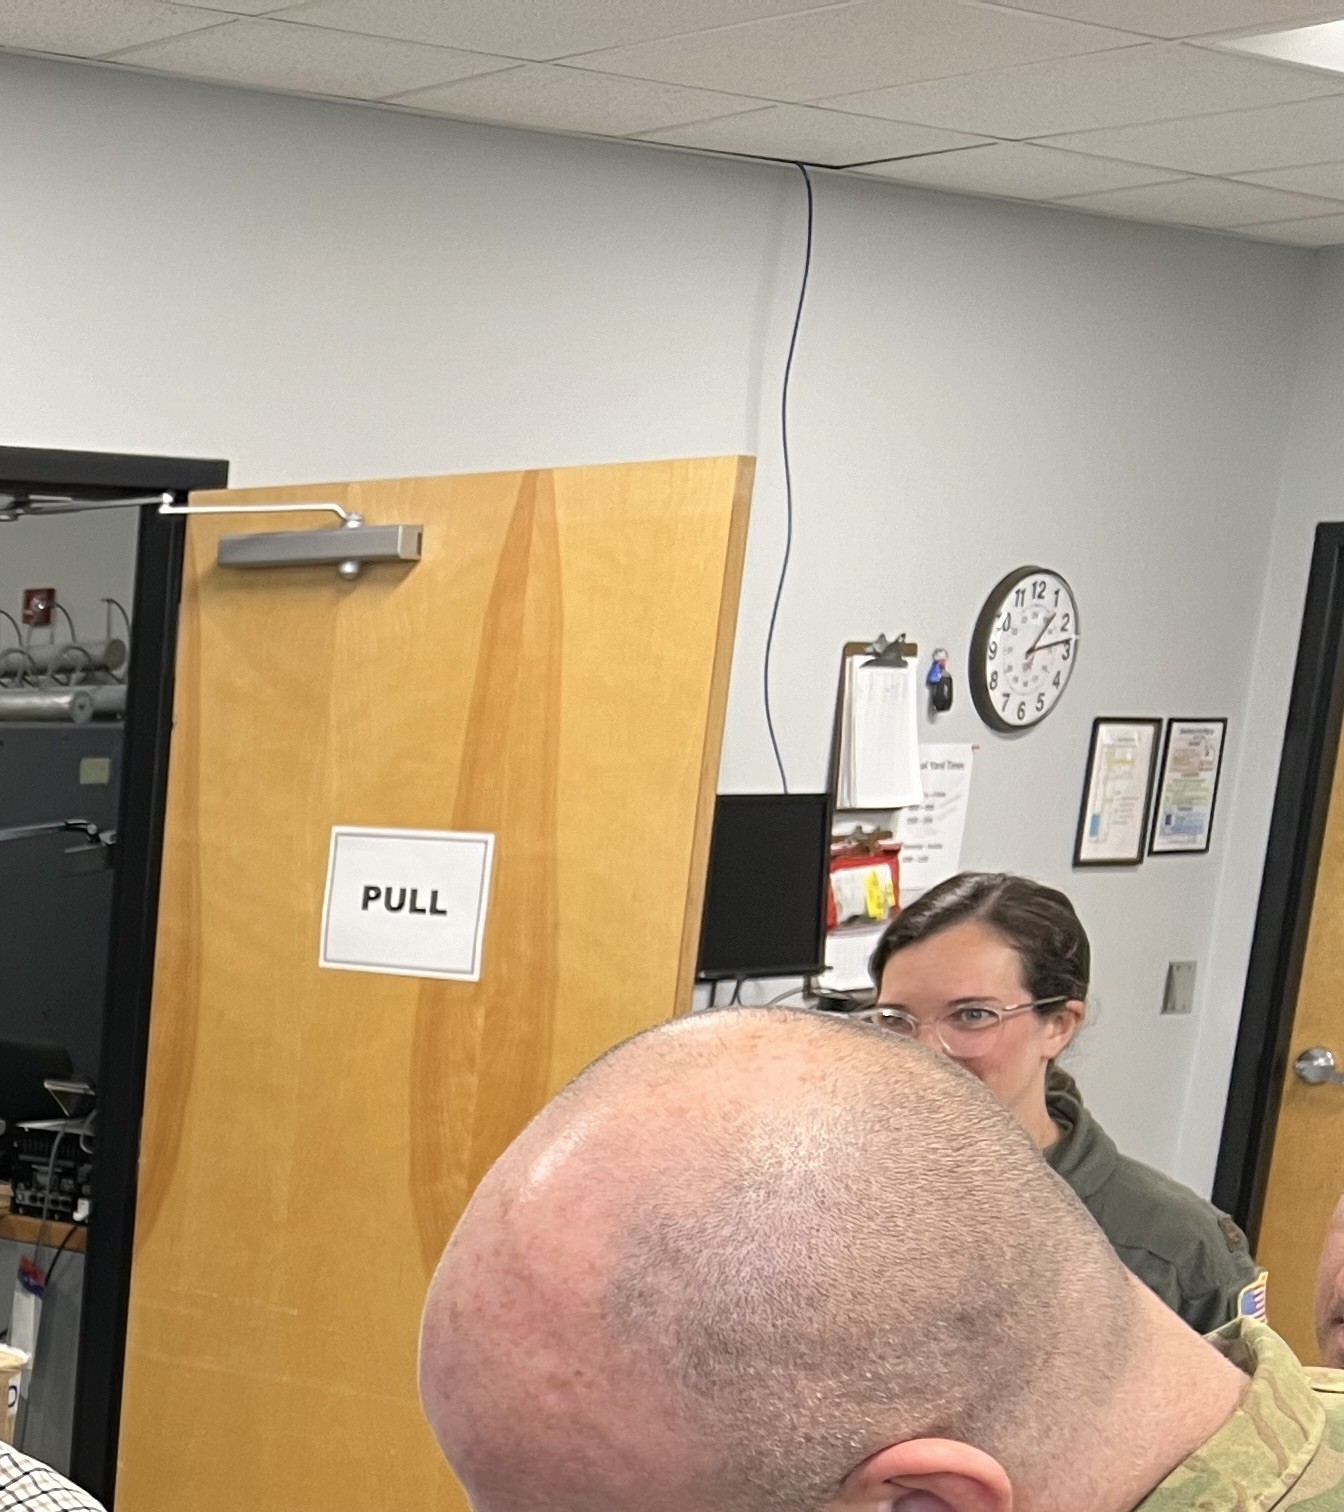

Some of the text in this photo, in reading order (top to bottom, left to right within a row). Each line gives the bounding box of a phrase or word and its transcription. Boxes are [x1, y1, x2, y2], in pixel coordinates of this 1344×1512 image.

[1015, 588, 1026, 607] 11
[1032, 581, 1047, 600] 12
[1054, 588, 1060, 607] 1
[1060, 613, 1070, 632] 2
[989, 641, 998, 661] 9
[1062, 638, 1071, 661] 3
[989, 670, 998, 690] 8
[1052, 670, 1061, 689] 4
[1001, 693, 1010, 712] 7
[1017, 701, 1026, 720] 6
[1035, 692, 1045, 712] 5
[361, 885, 448, 916] PULL
